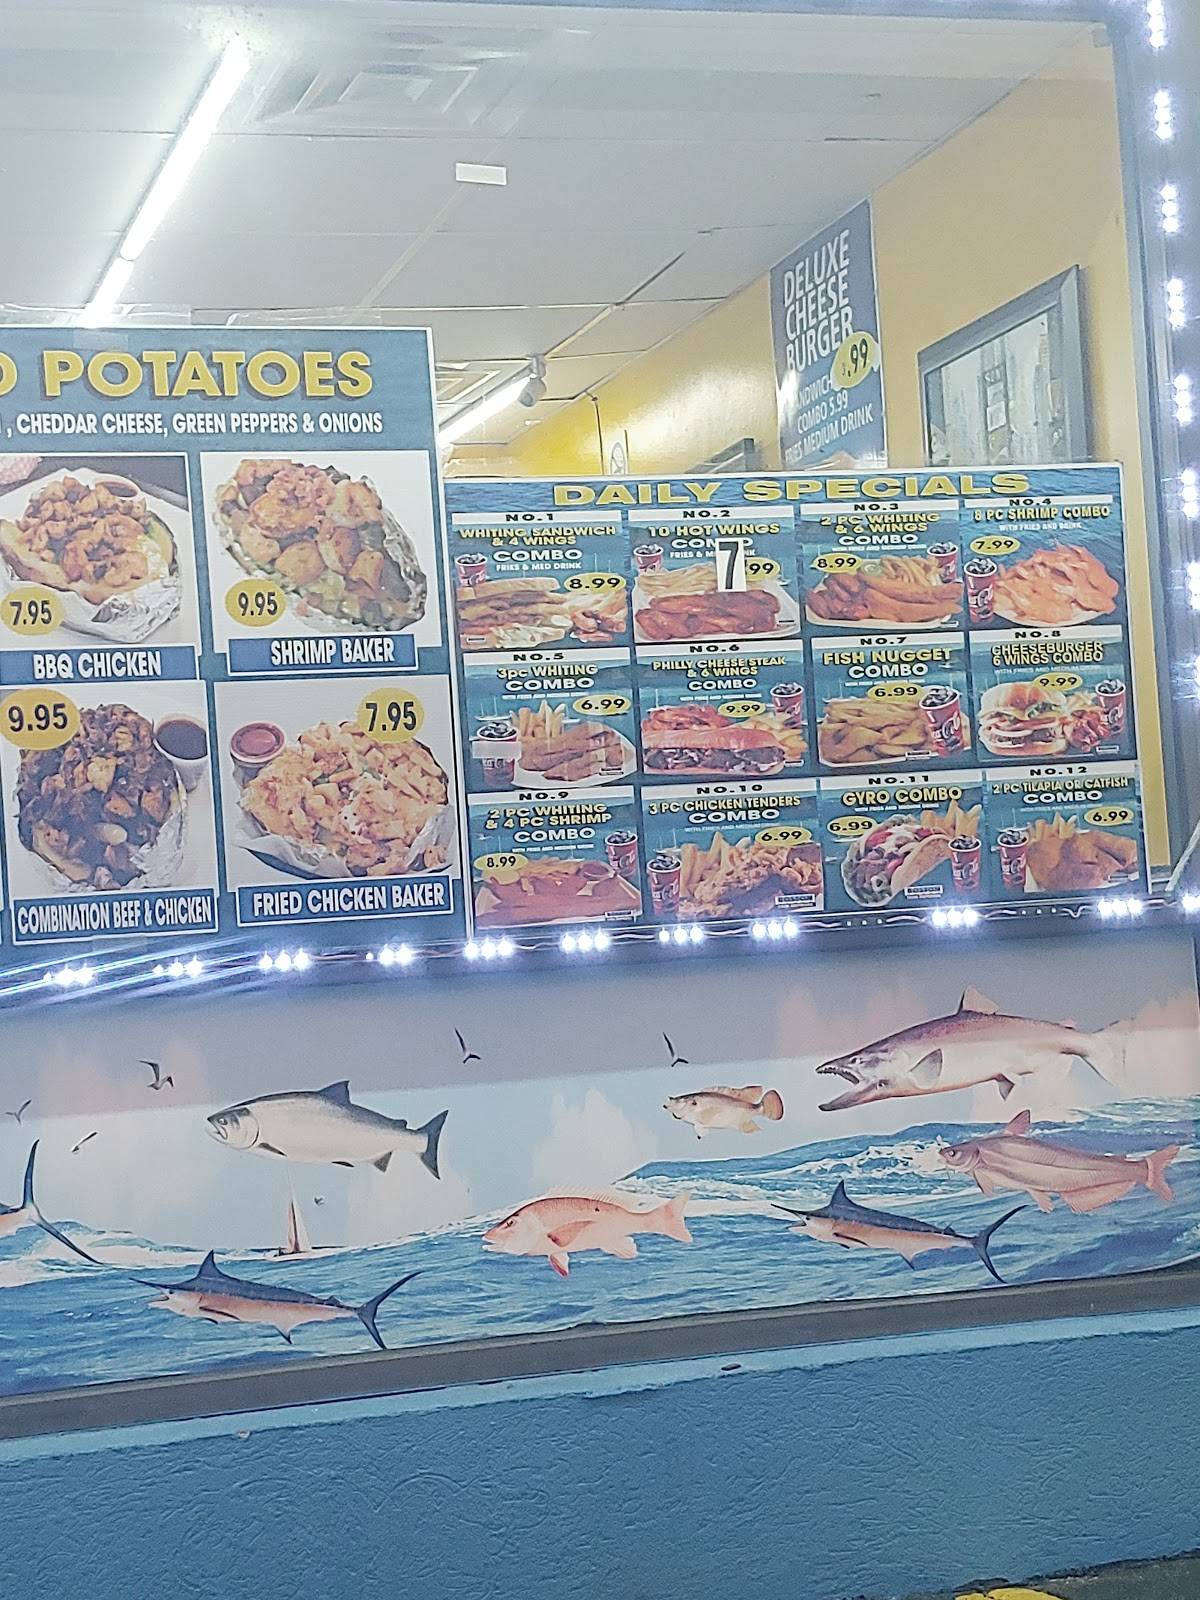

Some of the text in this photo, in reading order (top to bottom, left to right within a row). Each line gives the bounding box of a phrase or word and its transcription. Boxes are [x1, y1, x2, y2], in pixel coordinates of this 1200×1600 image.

[784, 229, 849, 308] DELUXE
[786, 268, 849, 341] CHEESE
[786, 306, 853, 372] BURGER
[43, 350, 373, 397] POTATOES
[798, 390, 848, 434] COMBO 5.99
[17, 413, 97, 434] CHEDDAR
[102, 412, 168, 438] CHEESE,
[172, 413, 226, 433] GREEN
[231, 412, 297, 433] PEPPERS
[302, 412, 315, 433] &
[319, 412, 383, 433] ONIONS
[803, 420, 839, 456] MEDIUM
[841, 403, 873, 435] DRINK
[553, 473, 1030, 506] DAILY SPECIALS
[854, 503, 899, 511] NO.3
[987, 510, 1003, 520] PC
[1008, 507, 1058, 520] SHRIMP
[1063, 505, 1110, 518] COMBO
[683, 510, 731, 518] NO.2
[821, 513, 941, 525] 2 PC WHITING
[460, 526, 616, 538] WHITING SANDWICH
[650, 523, 780, 537] 10 HOT WINGS
[835, 522, 928, 534] & 6 WINGS
[492, 536, 576, 546] & 4 WINGS
[839, 534, 918, 546] COMBO
[976, 540, 1014, 550] 7.99
[493, 549, 582, 562] COMBO
[496, 563, 519, 571] FRIES
[817, 557, 857, 568] 8.99
[569, 578, 621, 589] 8.99
[238, 592, 278, 617] 9.95
[10, 600, 52, 626] 7.95
[861, 637, 907, 645] NO.7
[271, 638, 395, 666] SHRIMP BAKER
[690, 645, 740, 653] NO.6
[991, 642, 1104, 655] CHEESEBURGER
[513, 653, 564, 661] NO.5
[823, 648, 952, 665] FISH NUGGET
[993, 651, 1103, 665] 6 WINGS COMBO
[33, 651, 161, 680] BBQ CHICKEN
[653, 657, 786, 670] PHILLY CHEESE STEAK
[531, 664, 598, 677] WHITING
[687, 666, 758, 678] & 6 WINGS
[848, 664, 929, 678] COMBO
[505, 678, 595, 691] COMBO
[688, 679, 757, 690] COMBO
[1040, 678, 1077, 686] 9.99
[874, 687, 918, 697] 6.99
[581, 698, 625, 710] 6.99
[726, 705, 761, 713] 9.99
[8, 704, 68, 732] 9.95
[365, 702, 417, 731] 7.95
[1030, 767, 1087, 776] NO.12
[868, 775, 929, 785] NO.11
[992, 777, 1128, 794] 2 PC TILAPIA OR CATFISH
[519, 792, 569, 800] NO.9
[697, 785, 763, 794] NO.10
[842, 786, 963, 806] GYRO COMBO
[1023, 791, 1103, 804] COMBO
[490, 803, 607, 819] 2 PC WHITING
[649, 796, 801, 815] 3 PC CHICKEN TENDERS
[486, 813, 612, 829] & 4 PC SHRIMP
[689, 809, 780, 823] COMBO
[1093, 811, 1128, 822] 6.99
[830, 822, 873, 831] 6.99
[514, 828, 595, 842] COMBO
[761, 831, 802, 841] 6.99
[486, 856, 516, 868] 8.99
[253, 883, 445, 917] FRIED CHICKEN BAKER
[17, 896, 212, 934] COMBINATION BEEF & CHICKEN
